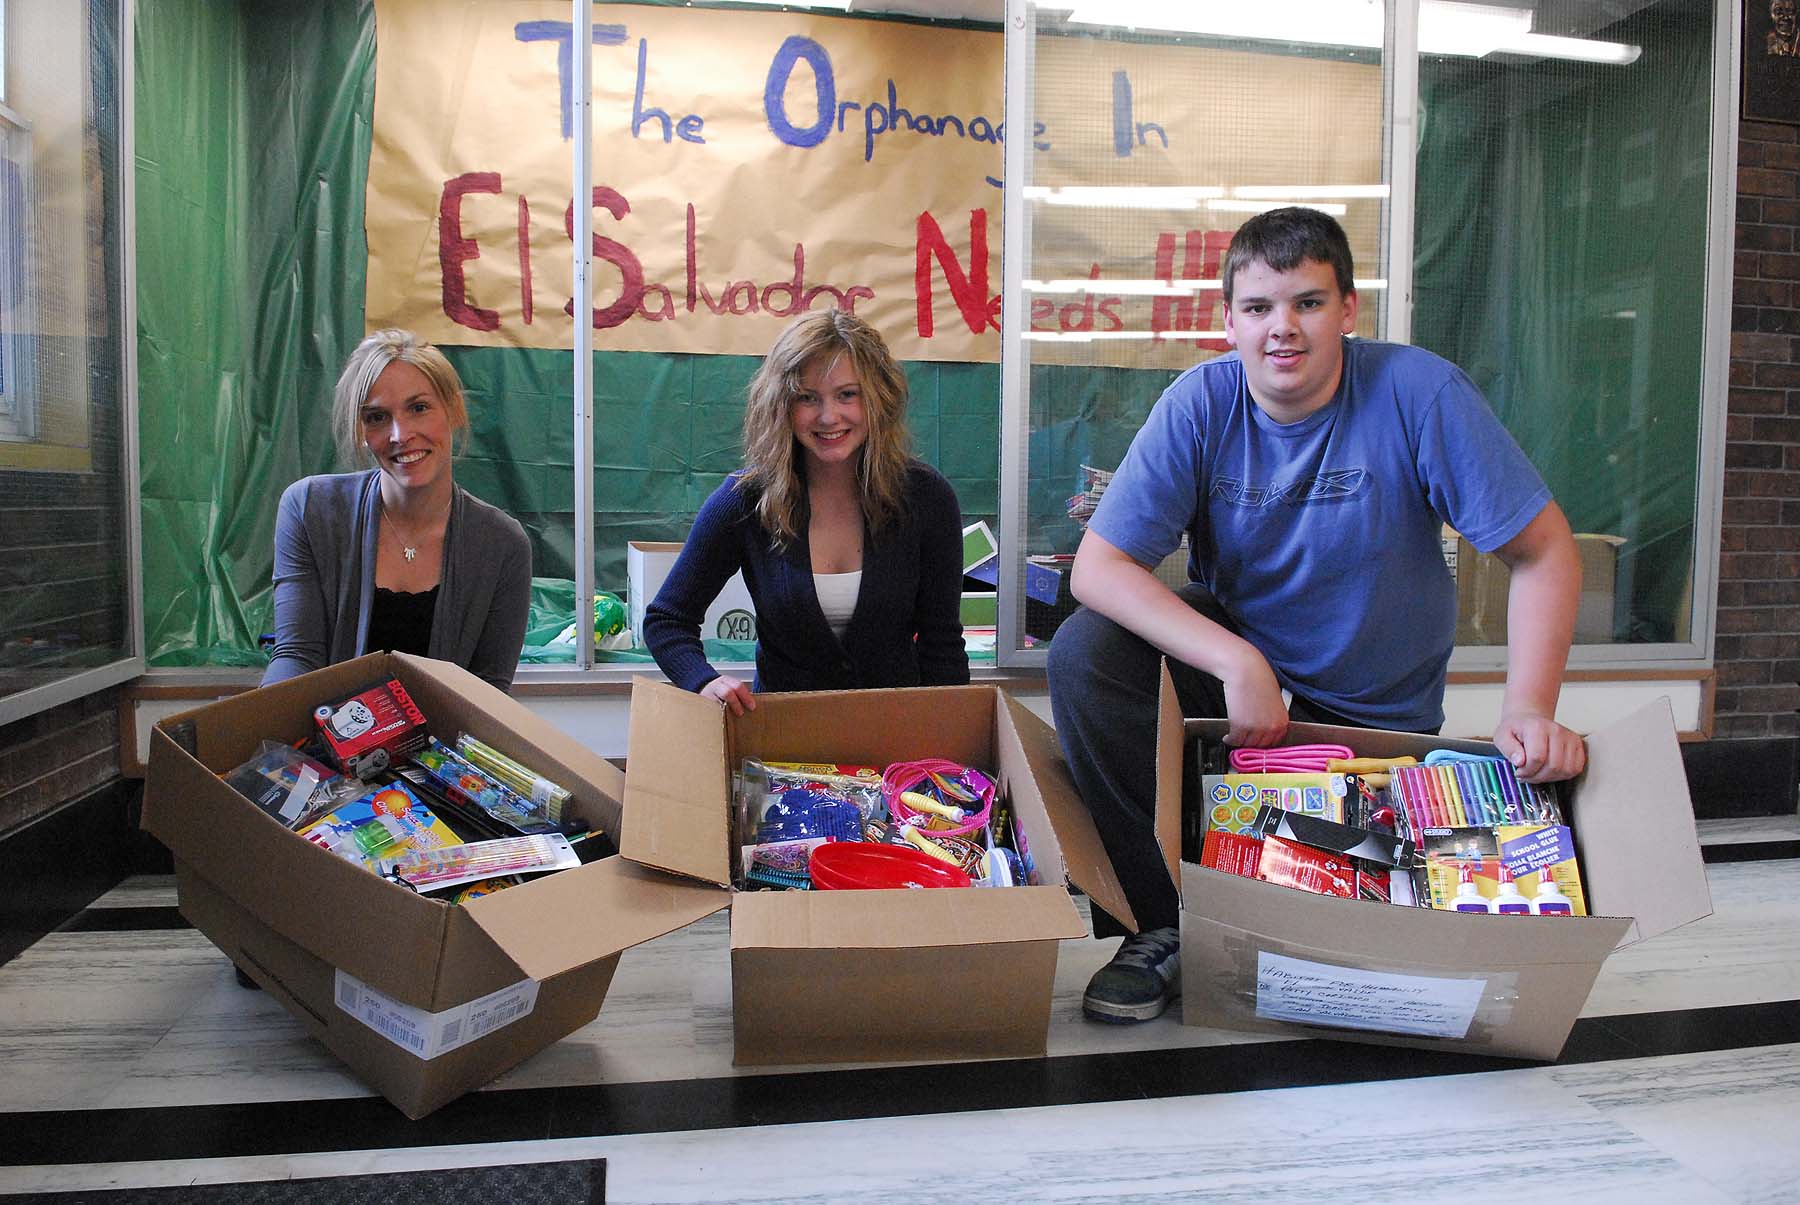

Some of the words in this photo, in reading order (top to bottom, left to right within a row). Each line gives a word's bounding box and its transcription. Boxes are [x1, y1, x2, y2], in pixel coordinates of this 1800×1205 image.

[514, 20, 706, 144] The
[1111, 69, 1169, 158] In
[438, 171, 533, 332] El
[564, 185, 876, 330] Salvador
[386, 679, 428, 726] BOSTON
[1535, 827, 1560, 840] WHITE
[1508, 857, 1527, 868] OLLE
[1526, 845, 1560, 862] BLANCHE
[1511, 843, 1540, 858] SCHOOL
[1540, 836, 1560, 847] GLUE
[1511, 866, 1528, 876] OUR
